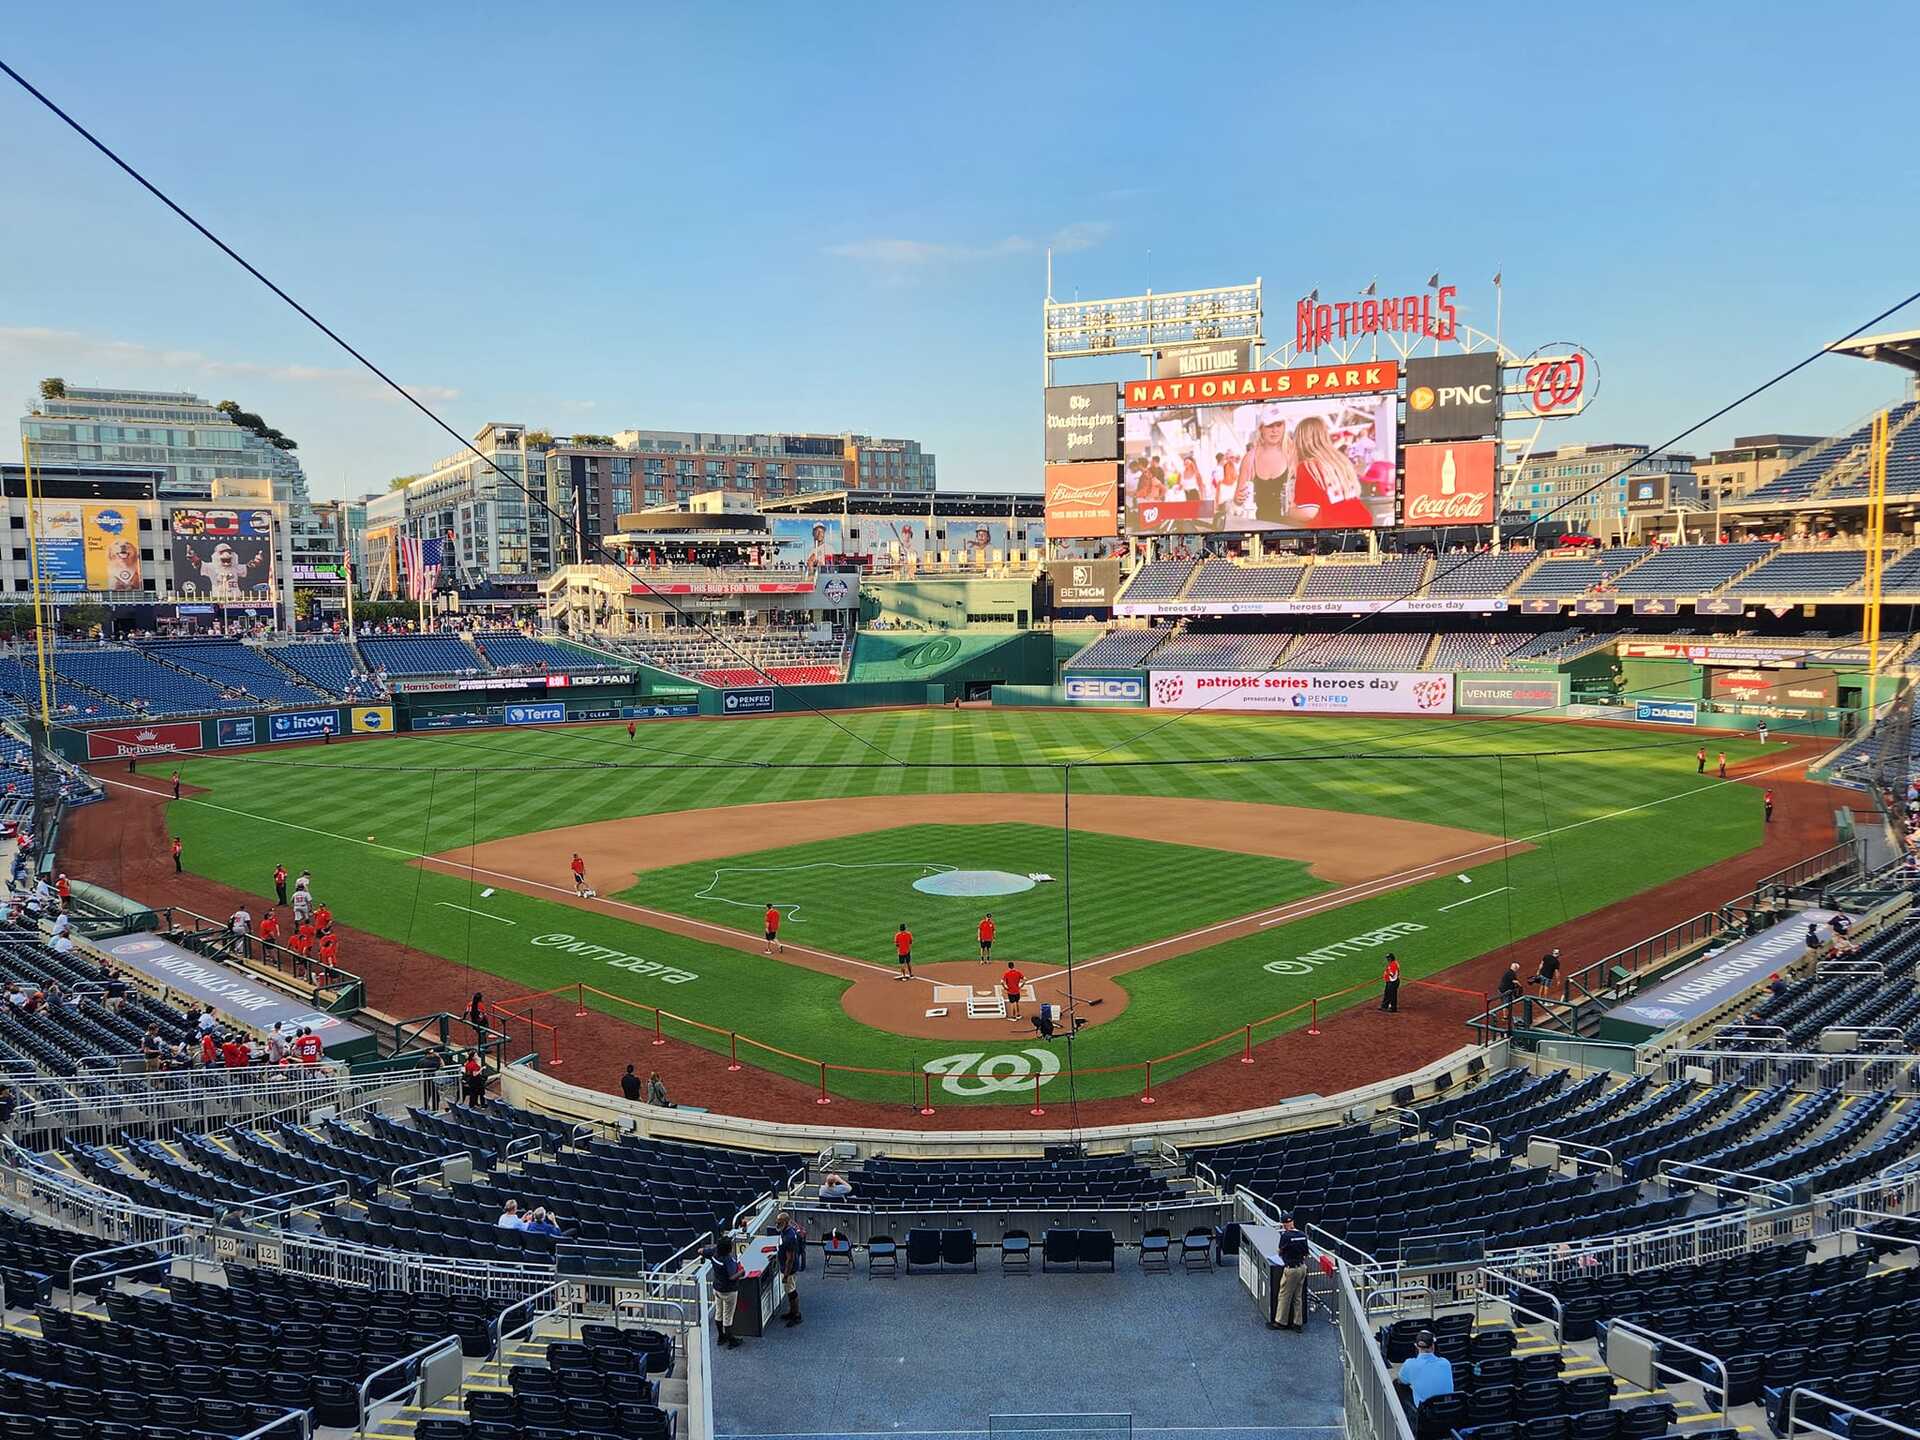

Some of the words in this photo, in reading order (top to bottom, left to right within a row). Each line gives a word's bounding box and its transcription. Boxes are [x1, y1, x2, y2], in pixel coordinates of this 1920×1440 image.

[1297, 286, 1457, 353] NATIONALS
[1179, 349, 1238, 375] NATITUDE
[1133, 375, 1292, 402] NATIONALS
[1306, 367, 1383, 389] PARK
[1069, 395, 1092, 409] The
[1439, 384, 1493, 407] PNC
[1047, 413, 1115, 429] Washington
[1066, 431, 1094, 450] Post
[689, 584, 704, 592] THIS
[730, 584, 742, 592] FOR
[1061, 588, 1105, 597] BETMGM
[1158, 604, 1188, 612] heroes
[1190, 603, 1207, 613] day
[1289, 602, 1323, 611] heroes
[1325, 602, 1342, 613] day
[1408, 601, 1442, 609] heroes
[1445, 601, 1464, 610] day
[603, 677, 630, 686] FAN
[1197, 675, 1260, 690] patriotic
[1264, 676, 1308, 689] series
[1313, 677, 1366, 689] heroes
[1370, 677, 1398, 691] day
[1068, 681, 1140, 696] GEICO
[1467, 689, 1512, 699] VENTURE
[1308, 695, 1348, 703] PENFED
[526, 708, 561, 720] Terra
[293, 715, 334, 729] inova
[117, 742, 177, 755] Budweiser
[150, 954, 238, 998] NATIONALS
[222, 985, 280, 1011] PARK
[1658, 953, 1765, 1005] WASHINGTON
[303, 1045, 317, 1055] 28
[1794, 1216, 1810, 1228] 125
[1753, 1224, 1769, 1238] 124
[217, 1239, 234, 1251] 120
[261, 1247, 277, 1260] 121
